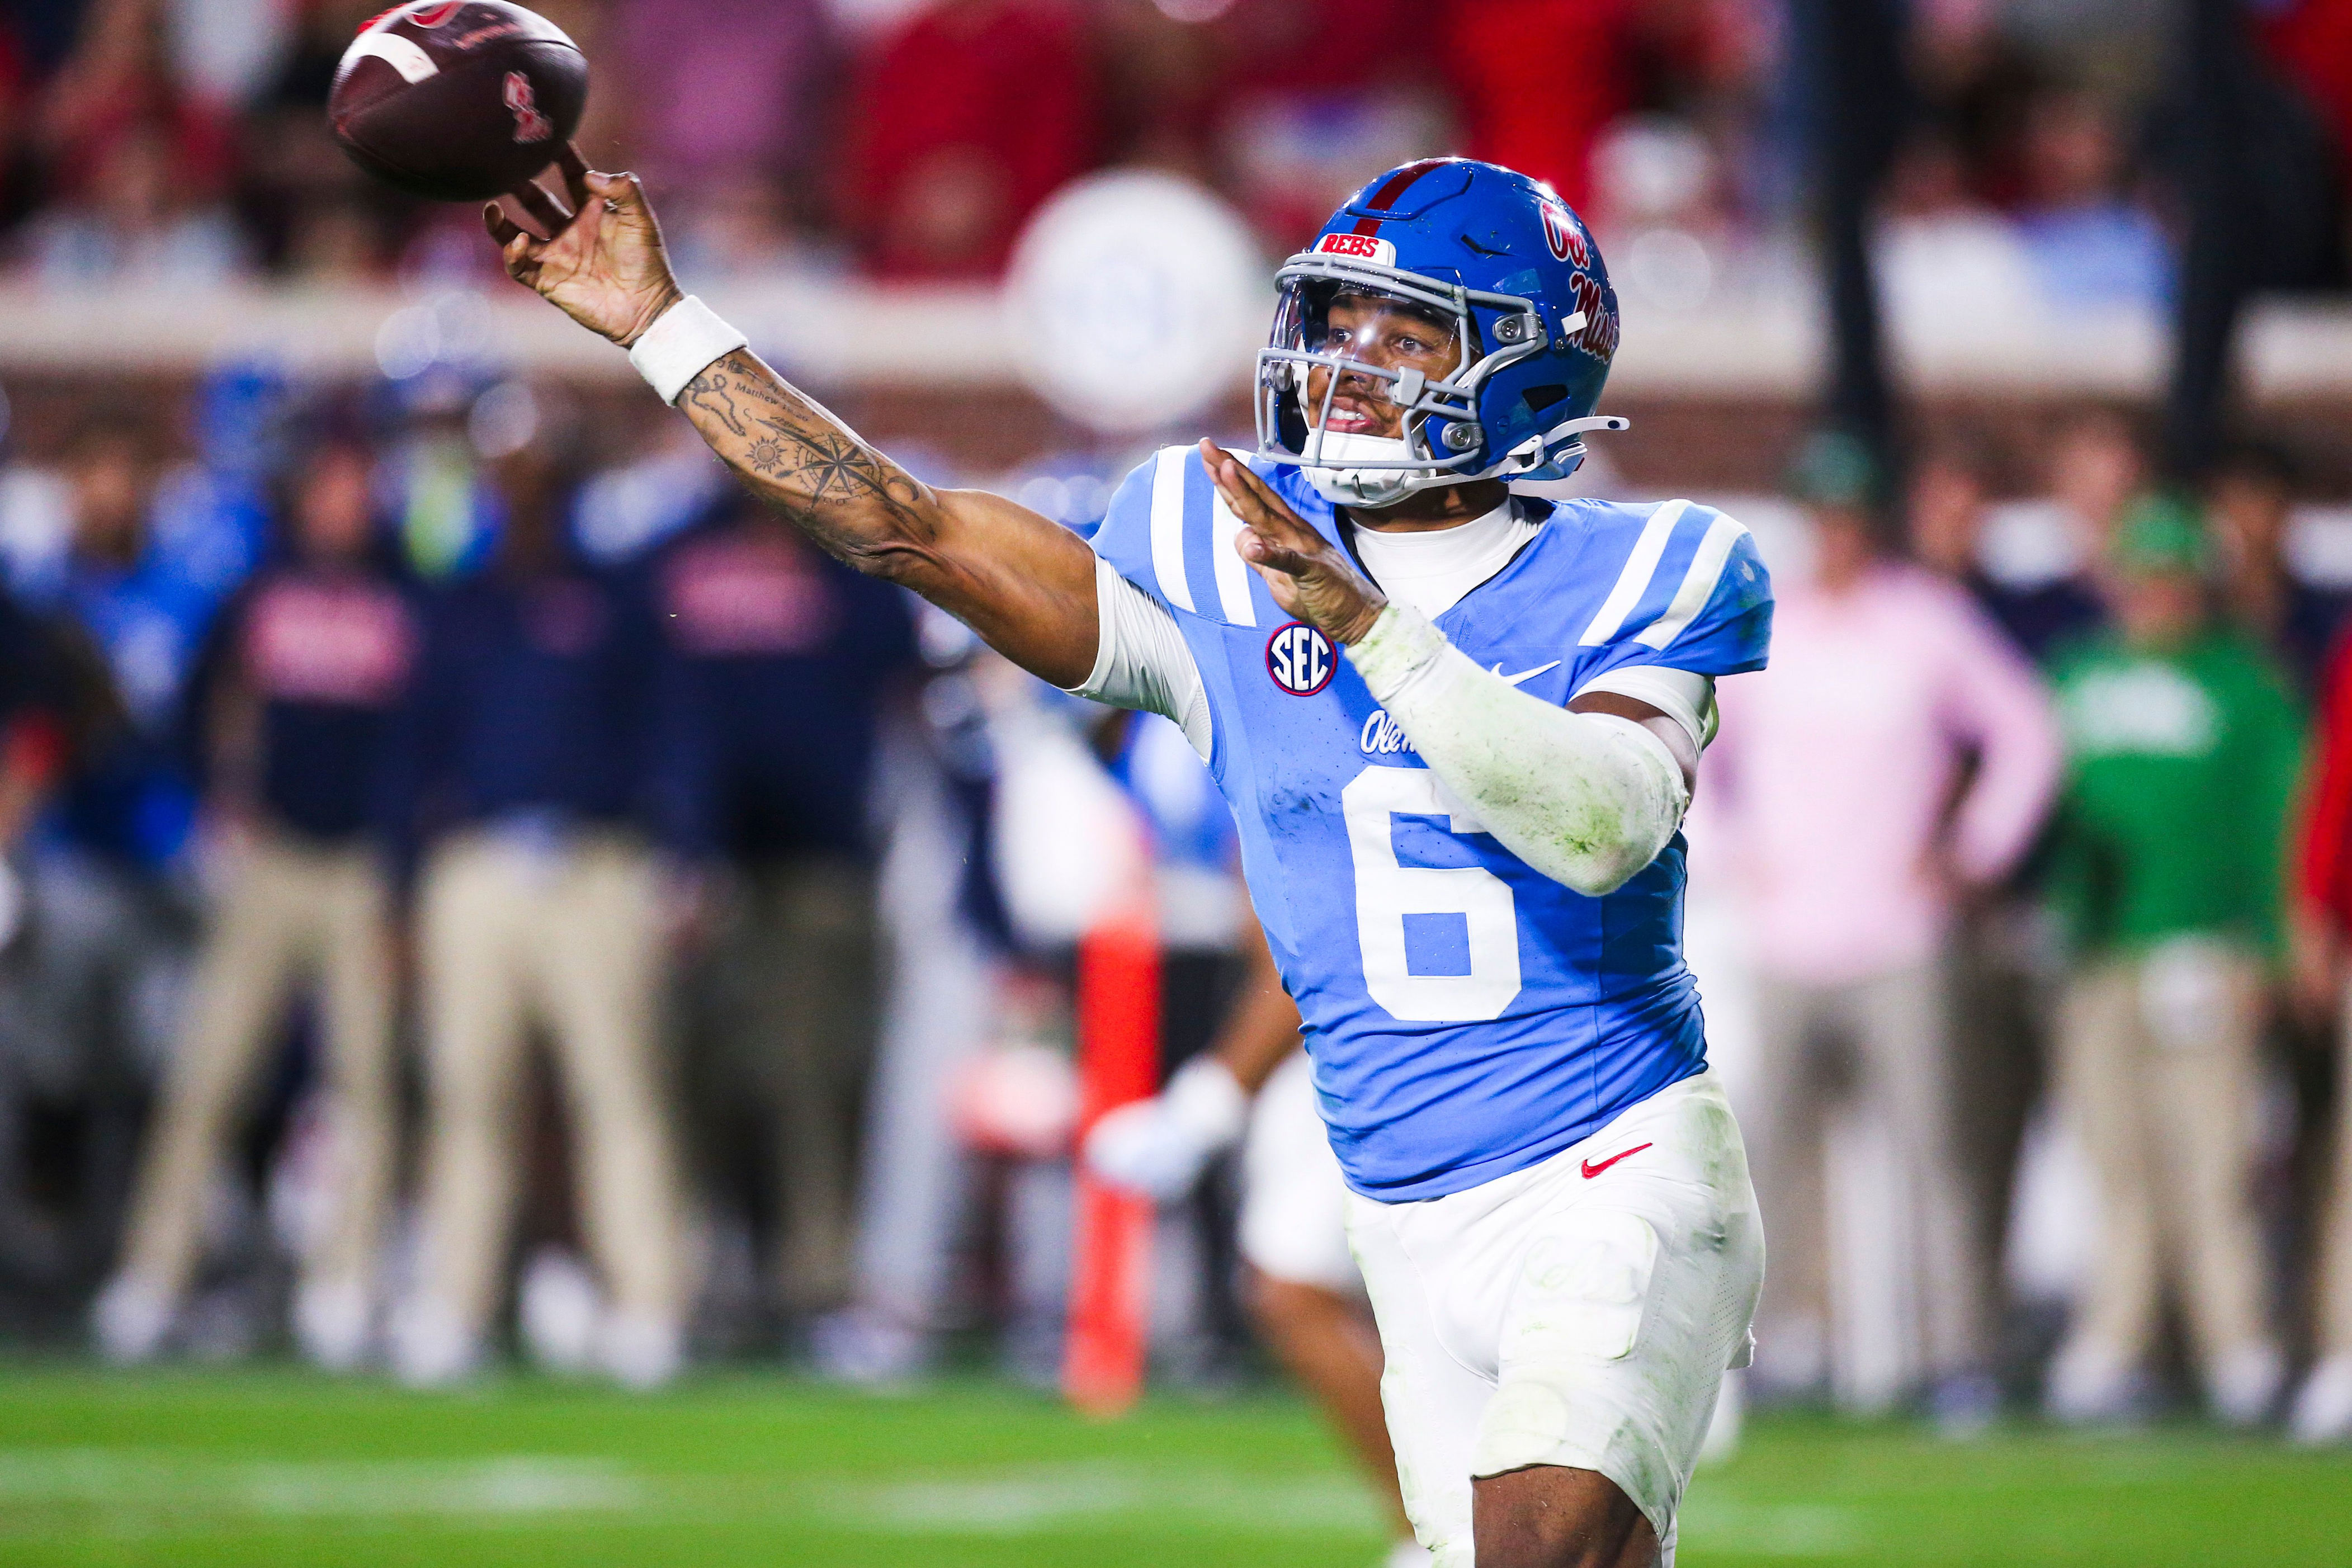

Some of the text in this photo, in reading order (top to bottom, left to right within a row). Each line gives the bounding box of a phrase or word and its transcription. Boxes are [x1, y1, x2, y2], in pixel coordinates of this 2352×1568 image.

[1321, 234, 1380, 258] REBS
[1539, 200, 1590, 271] Ole
[735, 382, 779, 405] Matthew
[1271, 626, 1330, 691] SEC
[1360, 709, 1403, 754] Ole
[1342, 765, 1522, 1022] 6
